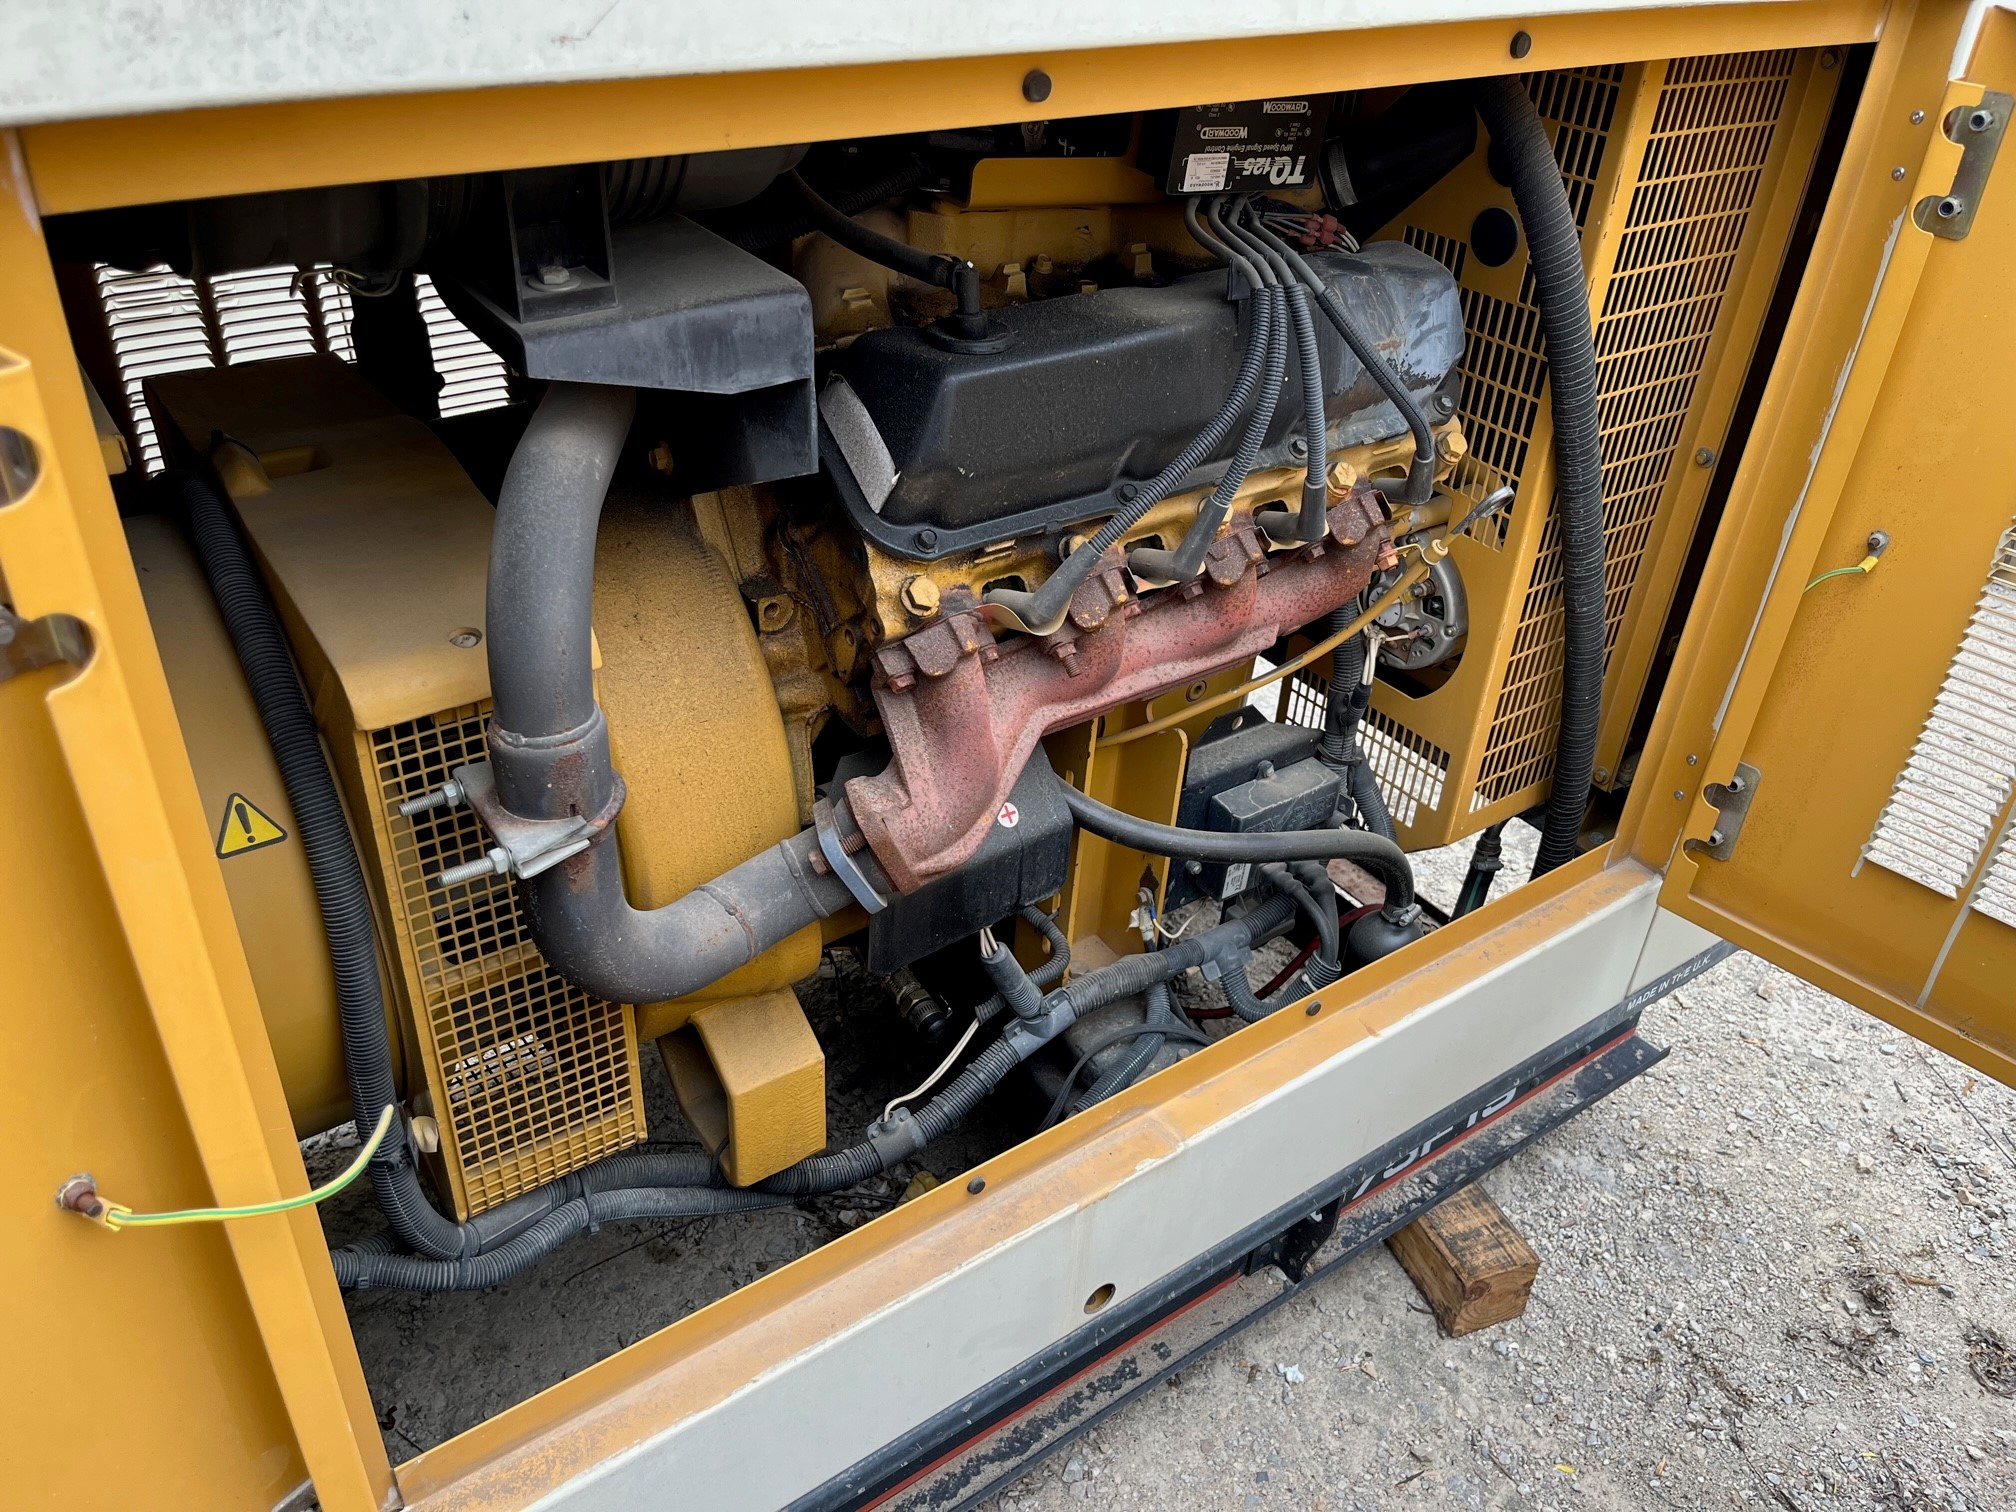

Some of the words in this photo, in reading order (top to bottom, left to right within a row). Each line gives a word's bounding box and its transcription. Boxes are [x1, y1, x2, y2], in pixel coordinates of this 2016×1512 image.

[1263, 101, 1308, 113] WOODWARD
[1200, 126, 1248, 139] WOODWARD
[1204, 145, 1226, 153] Control
[1226, 143, 1245, 153] Engine
[1245, 143, 1263, 152] Signal
[1262, 143, 1280, 152] Speed
[1626, 986, 1658, 1012] MADE
[1657, 979, 1671, 993] IN
[1671, 966, 1692, 985] THE
